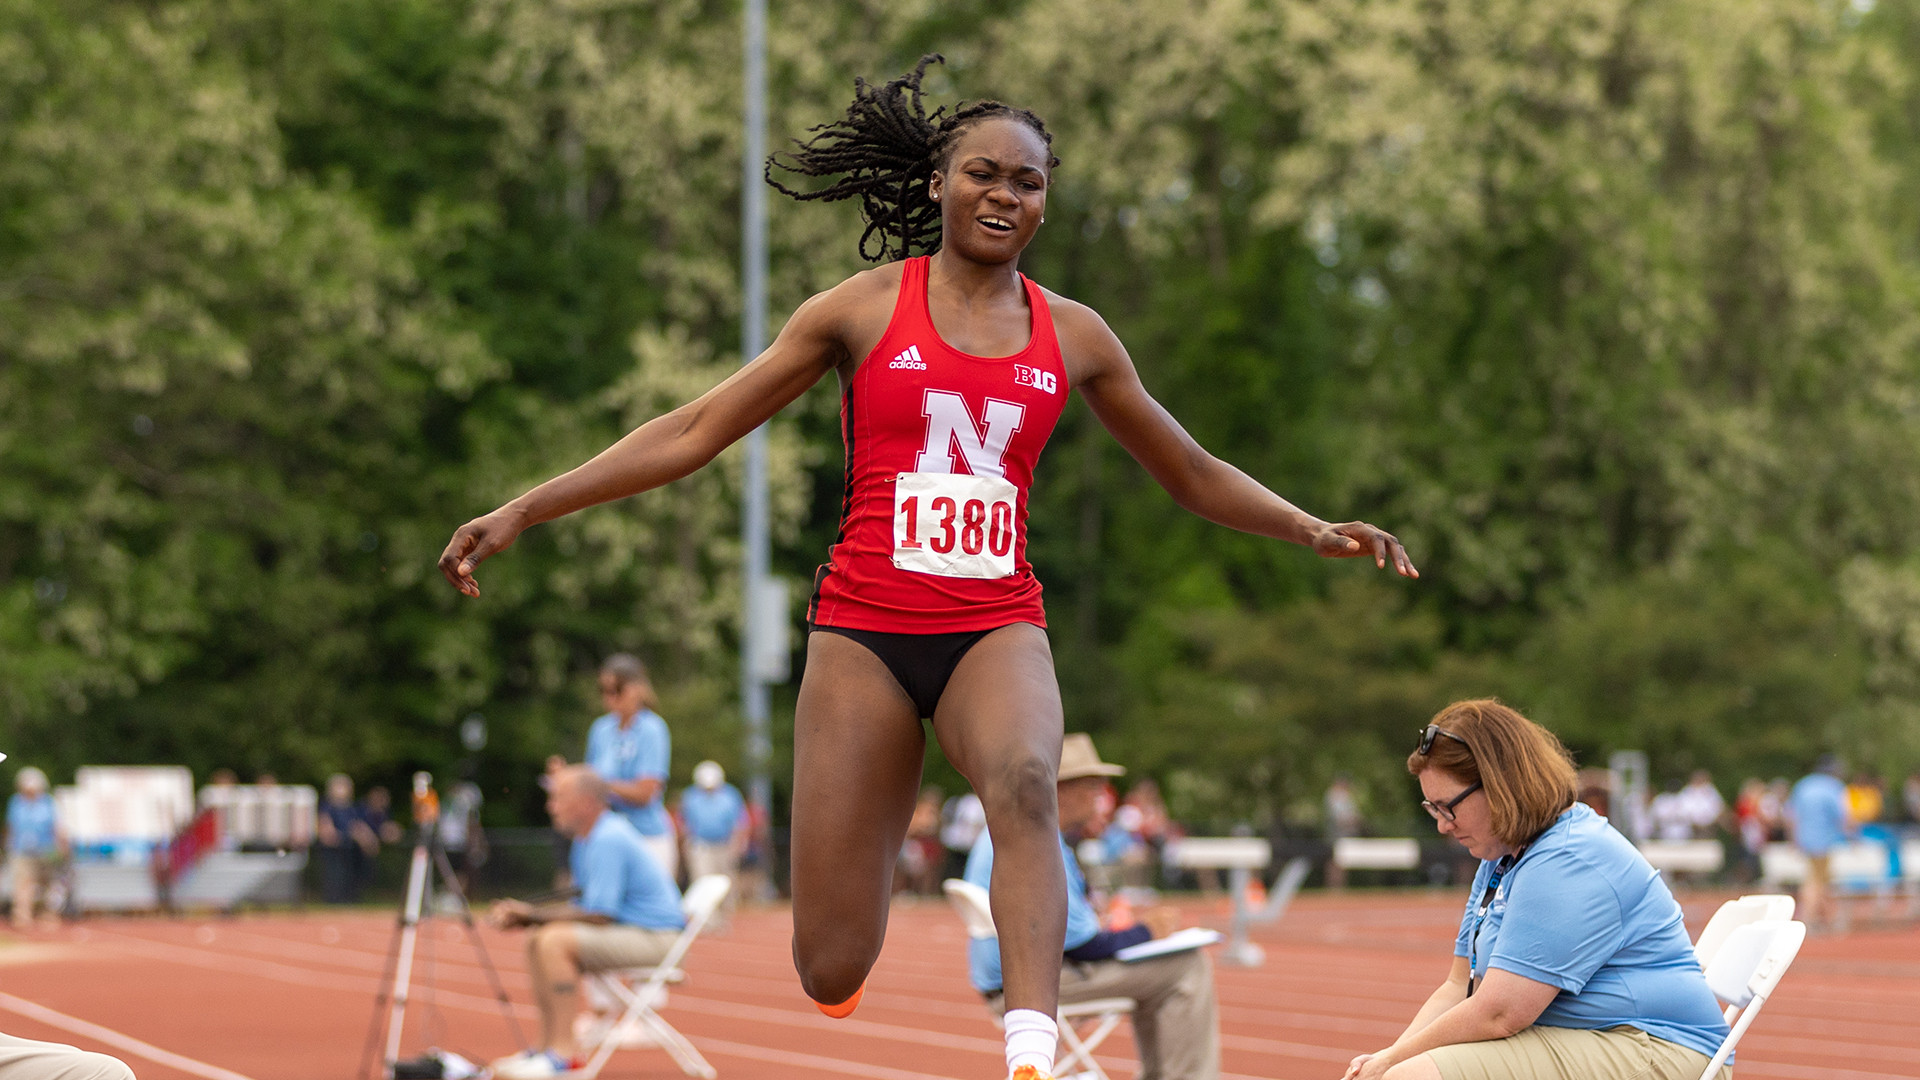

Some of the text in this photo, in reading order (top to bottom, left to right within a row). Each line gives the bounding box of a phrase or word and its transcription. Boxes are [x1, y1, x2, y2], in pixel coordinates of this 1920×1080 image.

[889, 359, 927, 371] adidas
[914, 387, 1027, 478] N
[901, 495, 1012, 557] 1380
